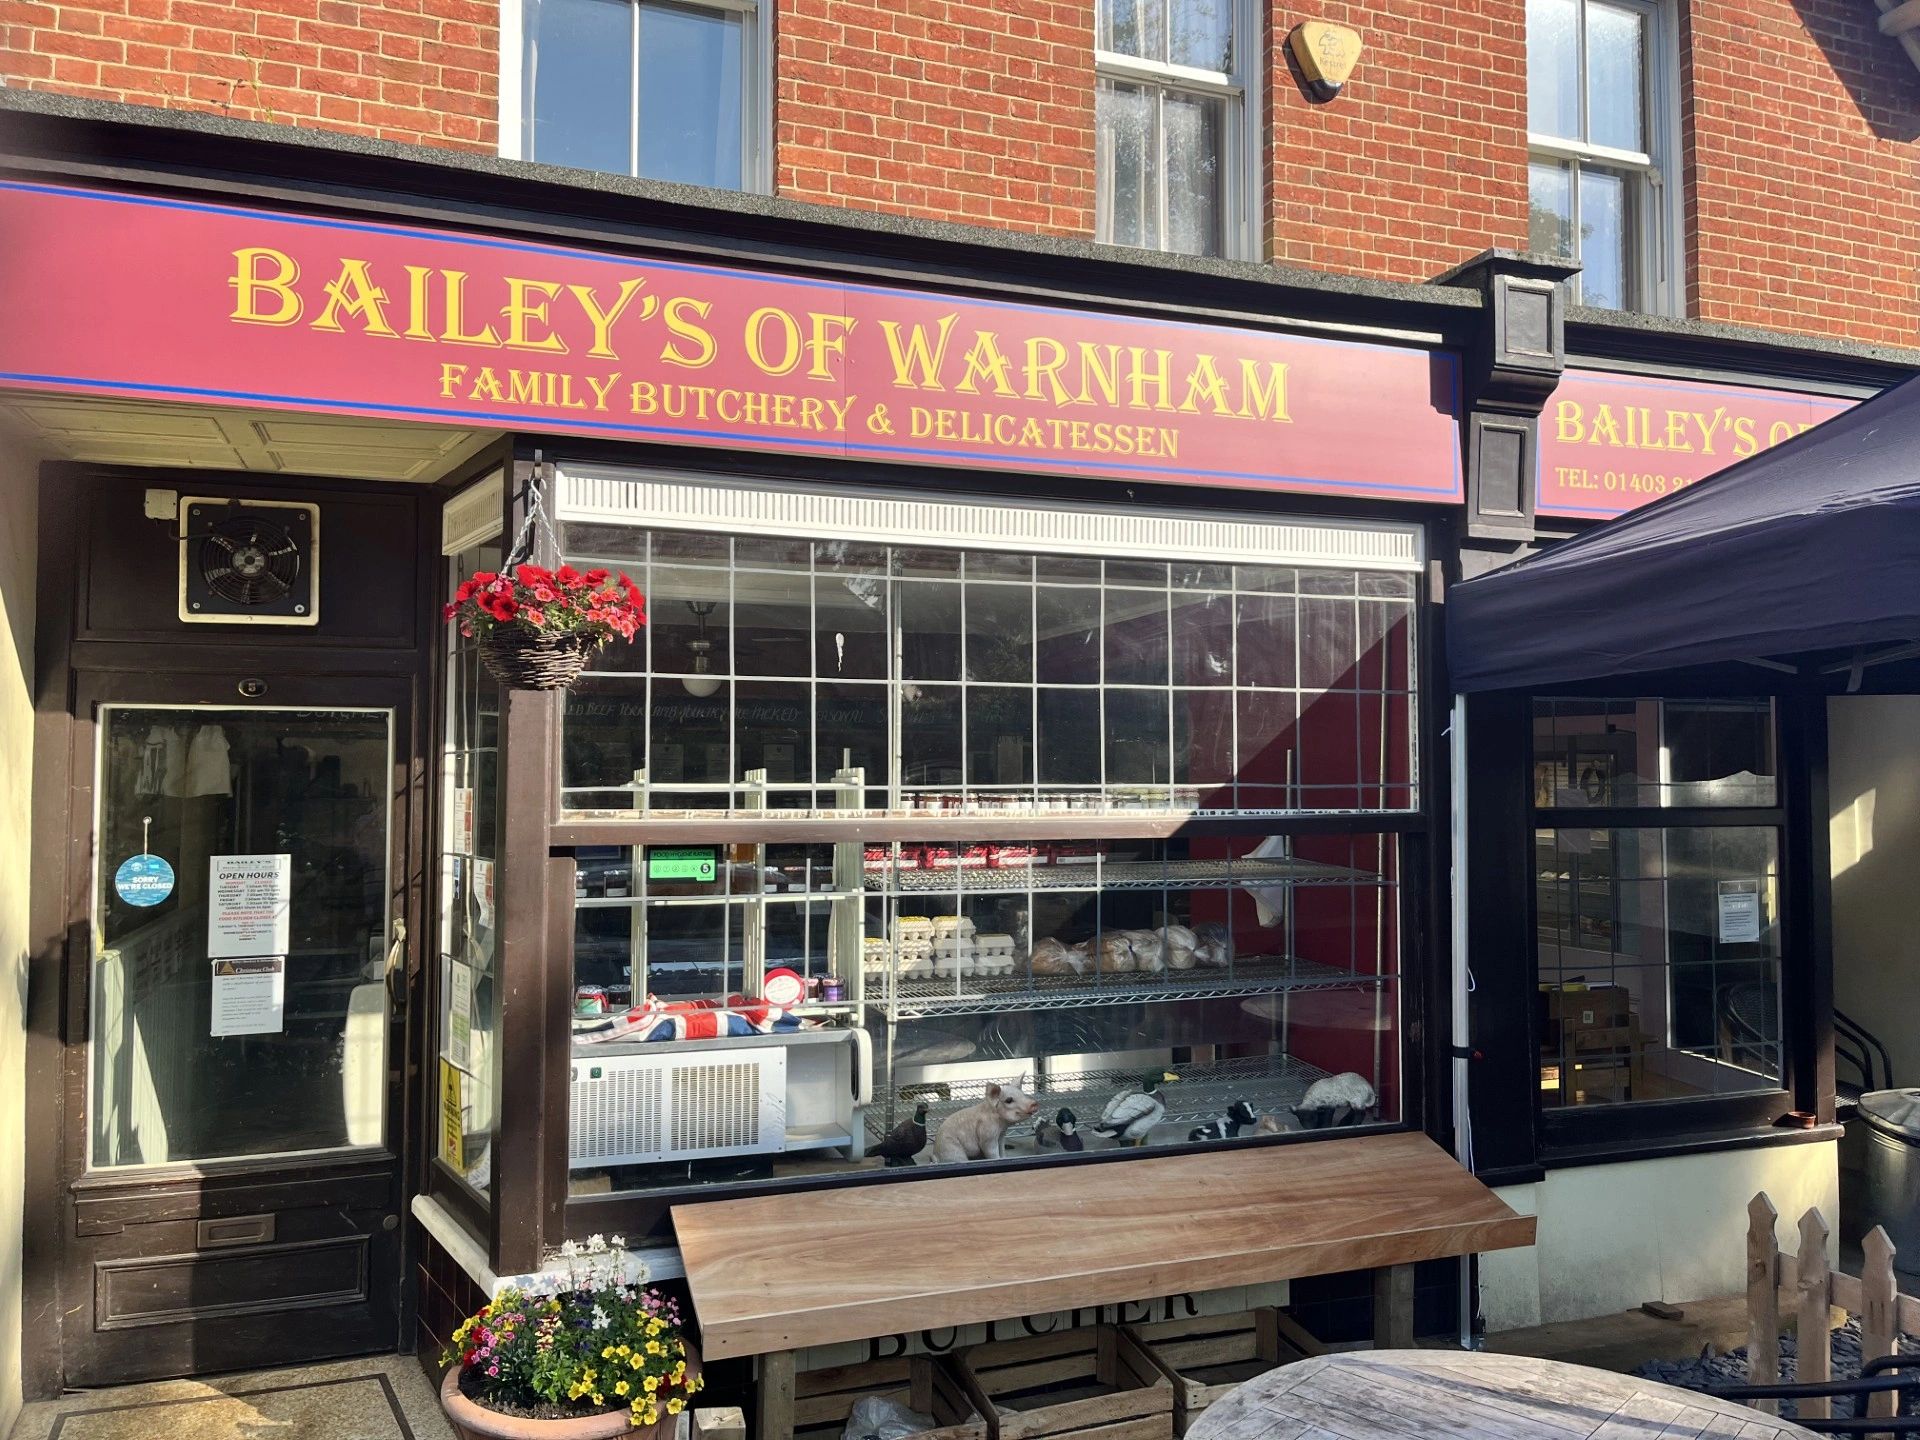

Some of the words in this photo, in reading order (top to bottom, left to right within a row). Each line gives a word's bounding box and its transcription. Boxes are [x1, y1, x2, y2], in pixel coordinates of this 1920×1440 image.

[228, 247, 717, 368] BAILEY'S
[743, 304, 858, 382] OF
[878, 311, 1294, 423] WARNHAM
[438, 362, 622, 412] FAMILY
[630, 380, 857, 431] BUTCHERY
[866, 402, 896, 436] &
[910, 408, 1180, 458] DELICATESSEN
[1554, 399, 1759, 458] BAILEY'S
[1768, 420, 1815, 448] O
[1554, 466, 1598, 490] TEL:
[1603, 470, 1667, 494] 01403
[219, 872, 245, 880] OPEN
[246, 871, 280, 879] HOURS
